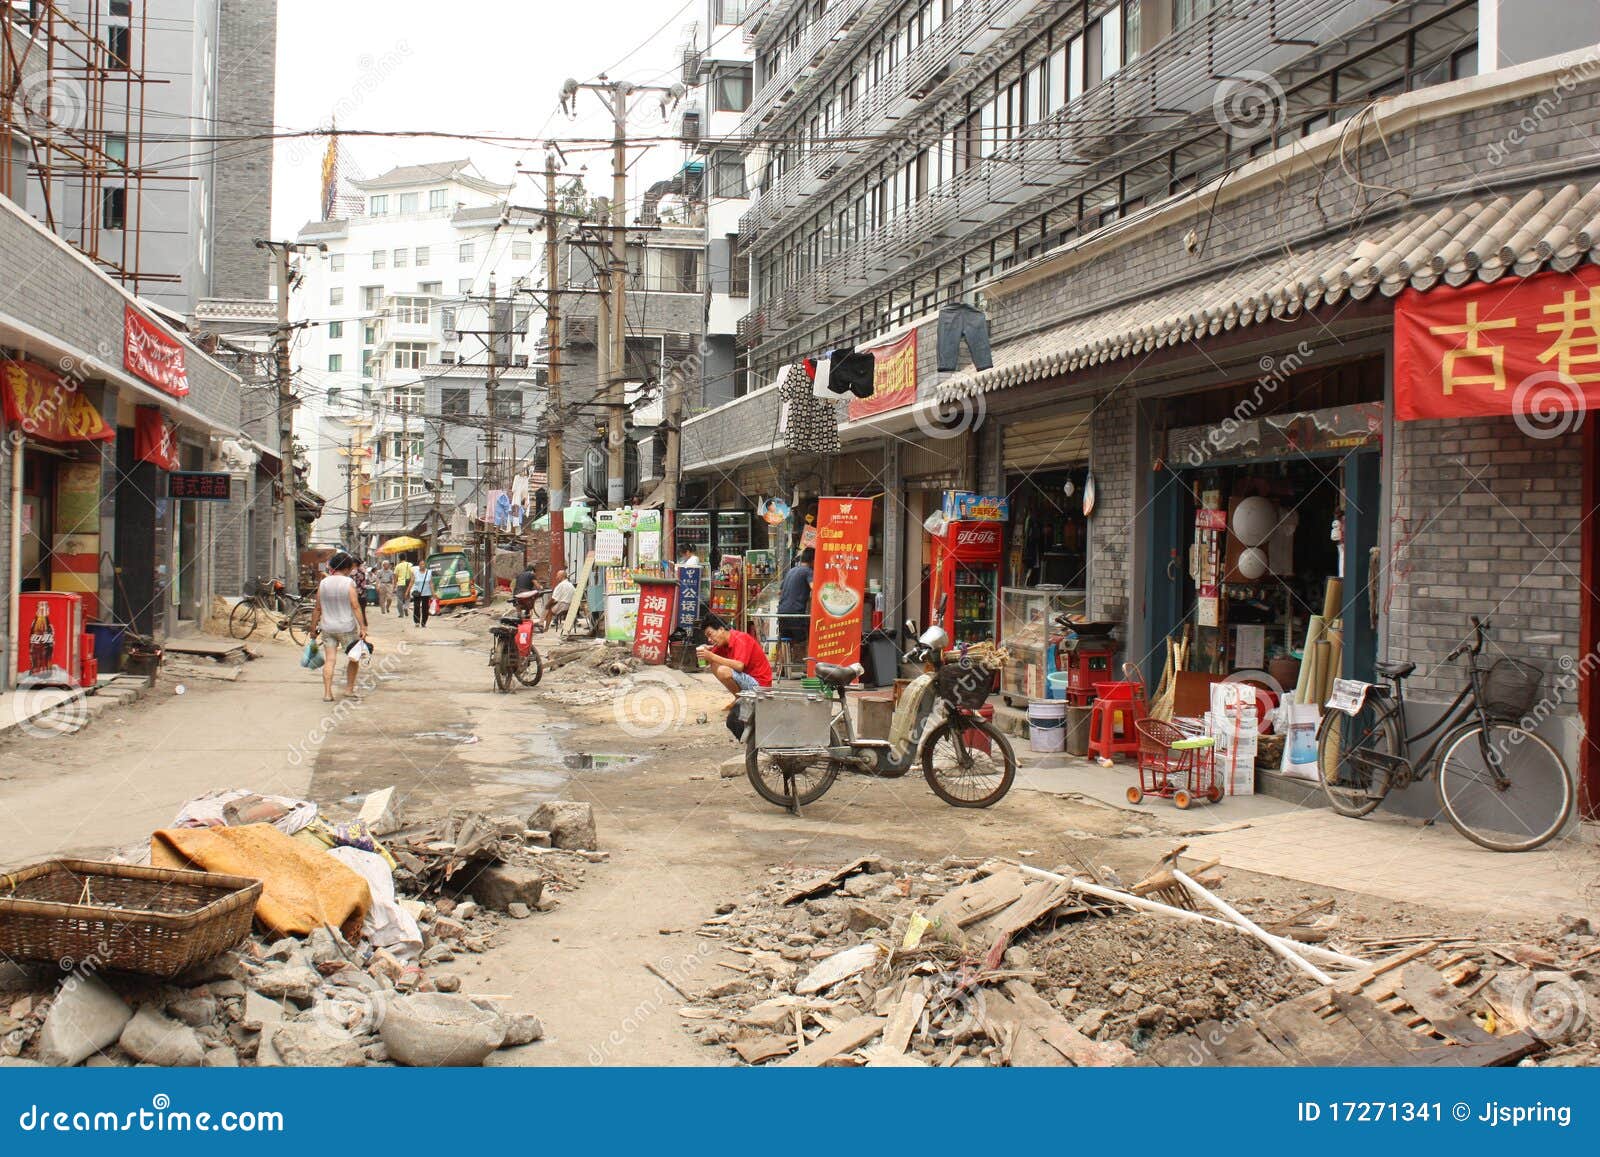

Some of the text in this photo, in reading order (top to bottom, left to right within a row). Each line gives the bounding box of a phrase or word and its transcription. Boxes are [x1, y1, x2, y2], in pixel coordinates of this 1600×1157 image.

[1429, 286, 1600, 396] 古巷
[637, 595, 668, 661] 湖南米粉
